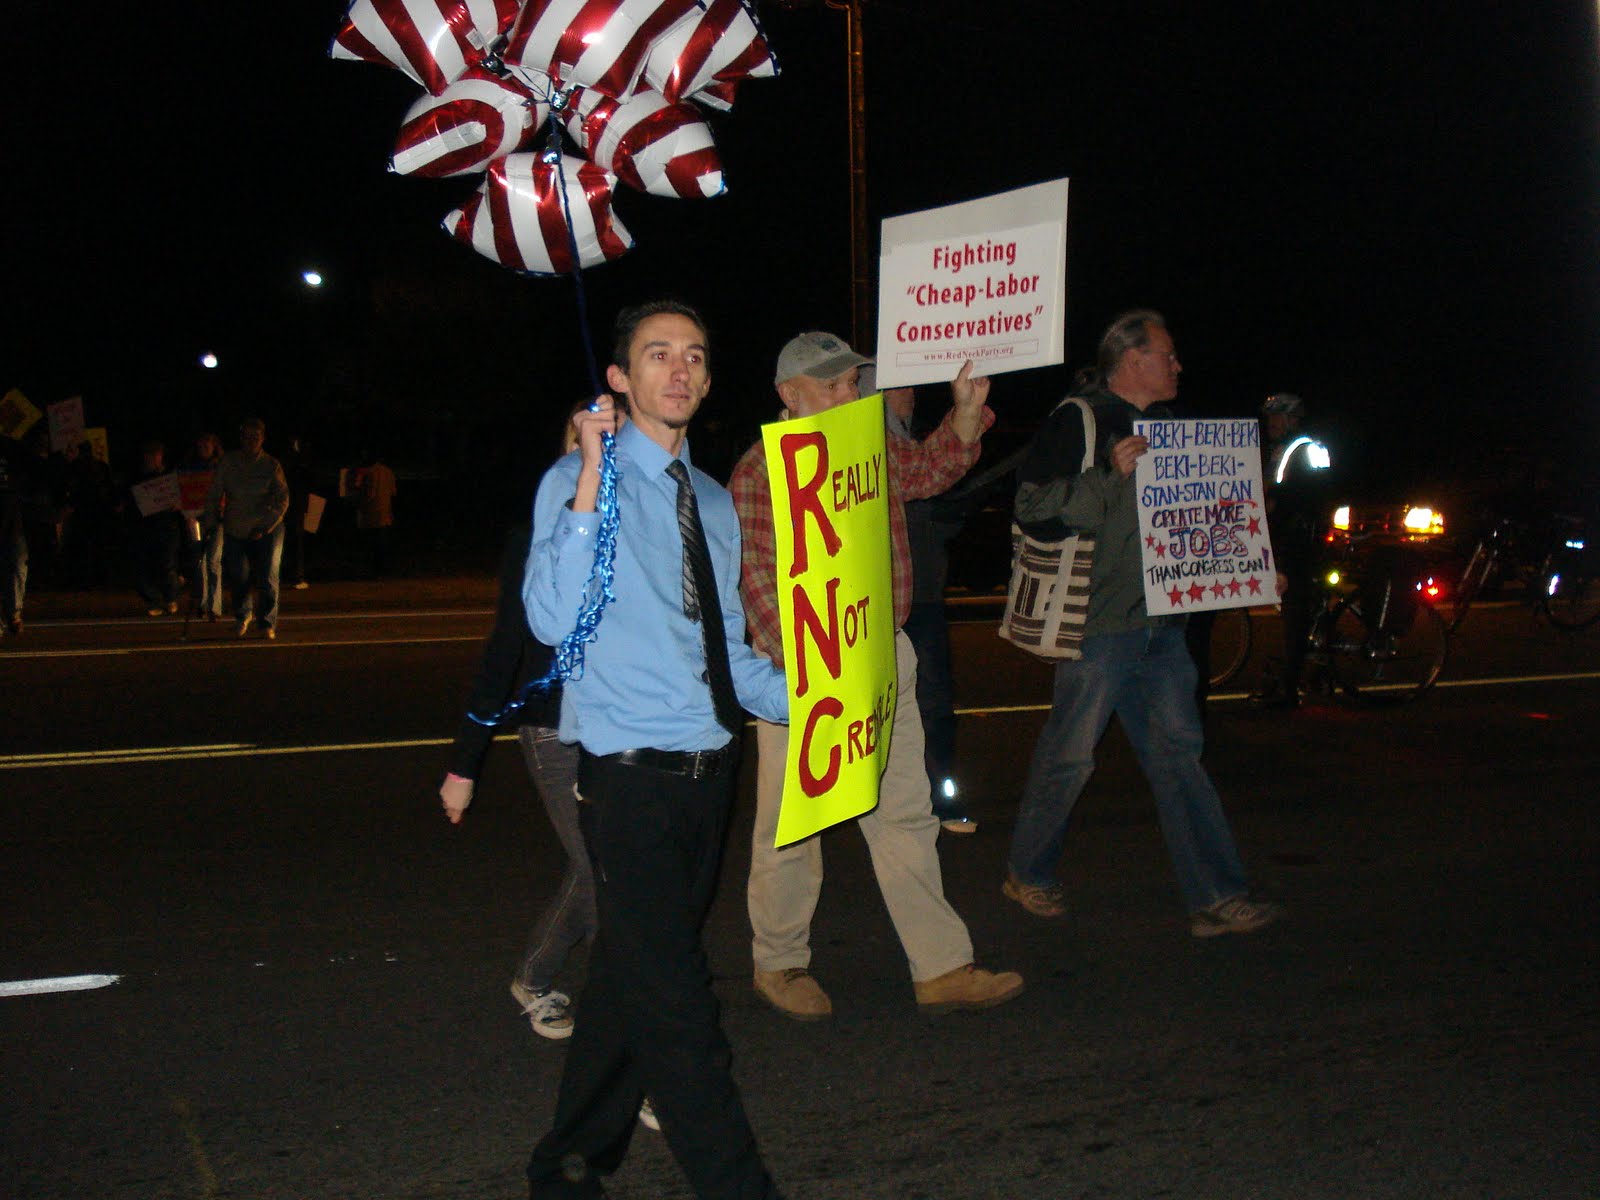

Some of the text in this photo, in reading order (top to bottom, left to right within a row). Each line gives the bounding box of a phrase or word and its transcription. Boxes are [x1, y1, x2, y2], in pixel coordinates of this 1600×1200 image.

[933, 240, 1017, 273] Fighting
[923, 346, 1015, 361] www.RedNeckParty.org
[1141, 480, 1252, 507] STAN-STAN CAN
[1168, 524, 1249, 560] JOBS
[1146, 564, 1183, 592] THAN
[798, 681, 894, 799] CRELE
